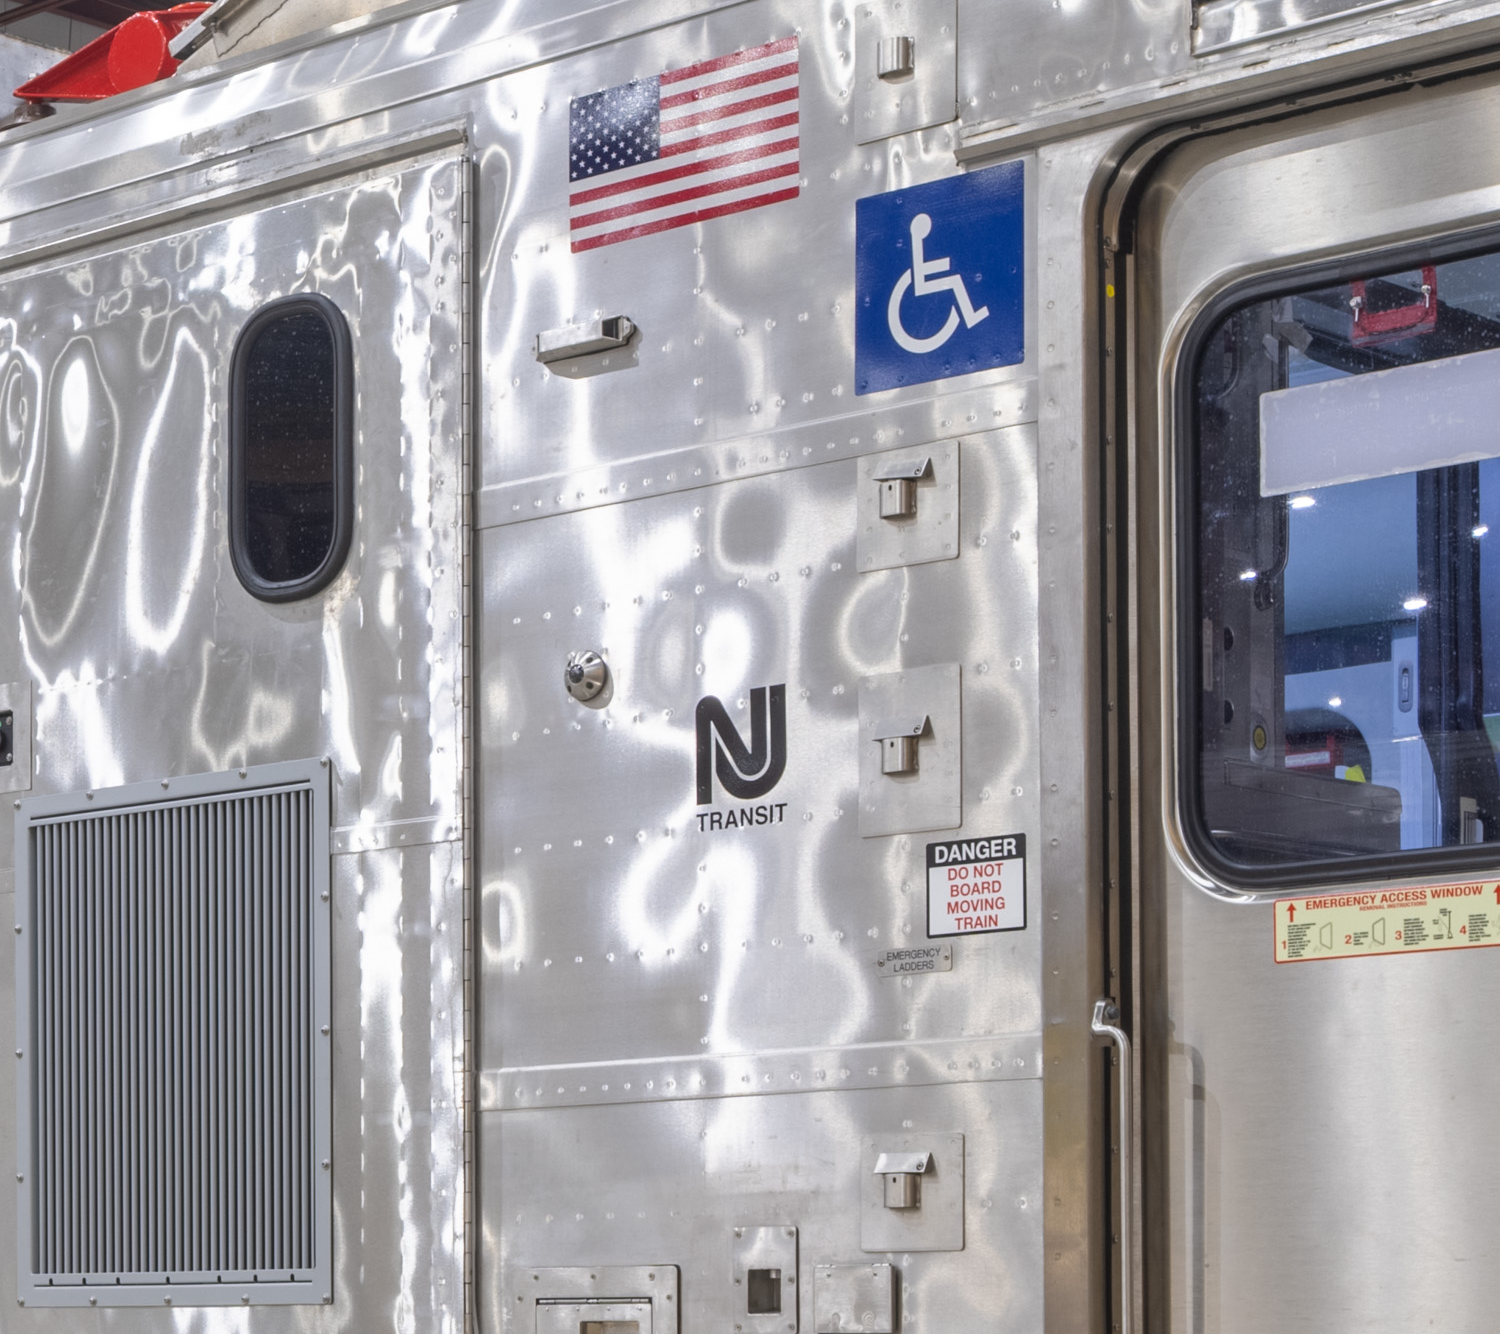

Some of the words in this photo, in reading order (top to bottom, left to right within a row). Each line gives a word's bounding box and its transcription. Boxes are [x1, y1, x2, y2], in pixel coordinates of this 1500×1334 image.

[696, 683, 786, 806] NJ
[696, 802, 788, 832] TRANSIT
[935, 838, 1016, 864] DANGER
[948, 866, 968, 881] DO
[974, 863, 1004, 878] NOT
[950, 880, 1002, 898] BOARD
[947, 897, 1006, 914] MOVING
[1306, 894, 1377, 910] EMERGENCY
[1380, 890, 1426, 903] ACCESS
[1431, 885, 1484, 899] WINDOW
[955, 914, 998, 930] TRAIN
[1395, 930, 1402, 940] 3
[1460, 926, 1466, 935] 4
[1282, 940, 1286, 950] 1
[1344, 934, 1352, 944] 2
[886, 947, 941, 962] EMERGENCY
[894, 960, 934, 973] LADDERS
